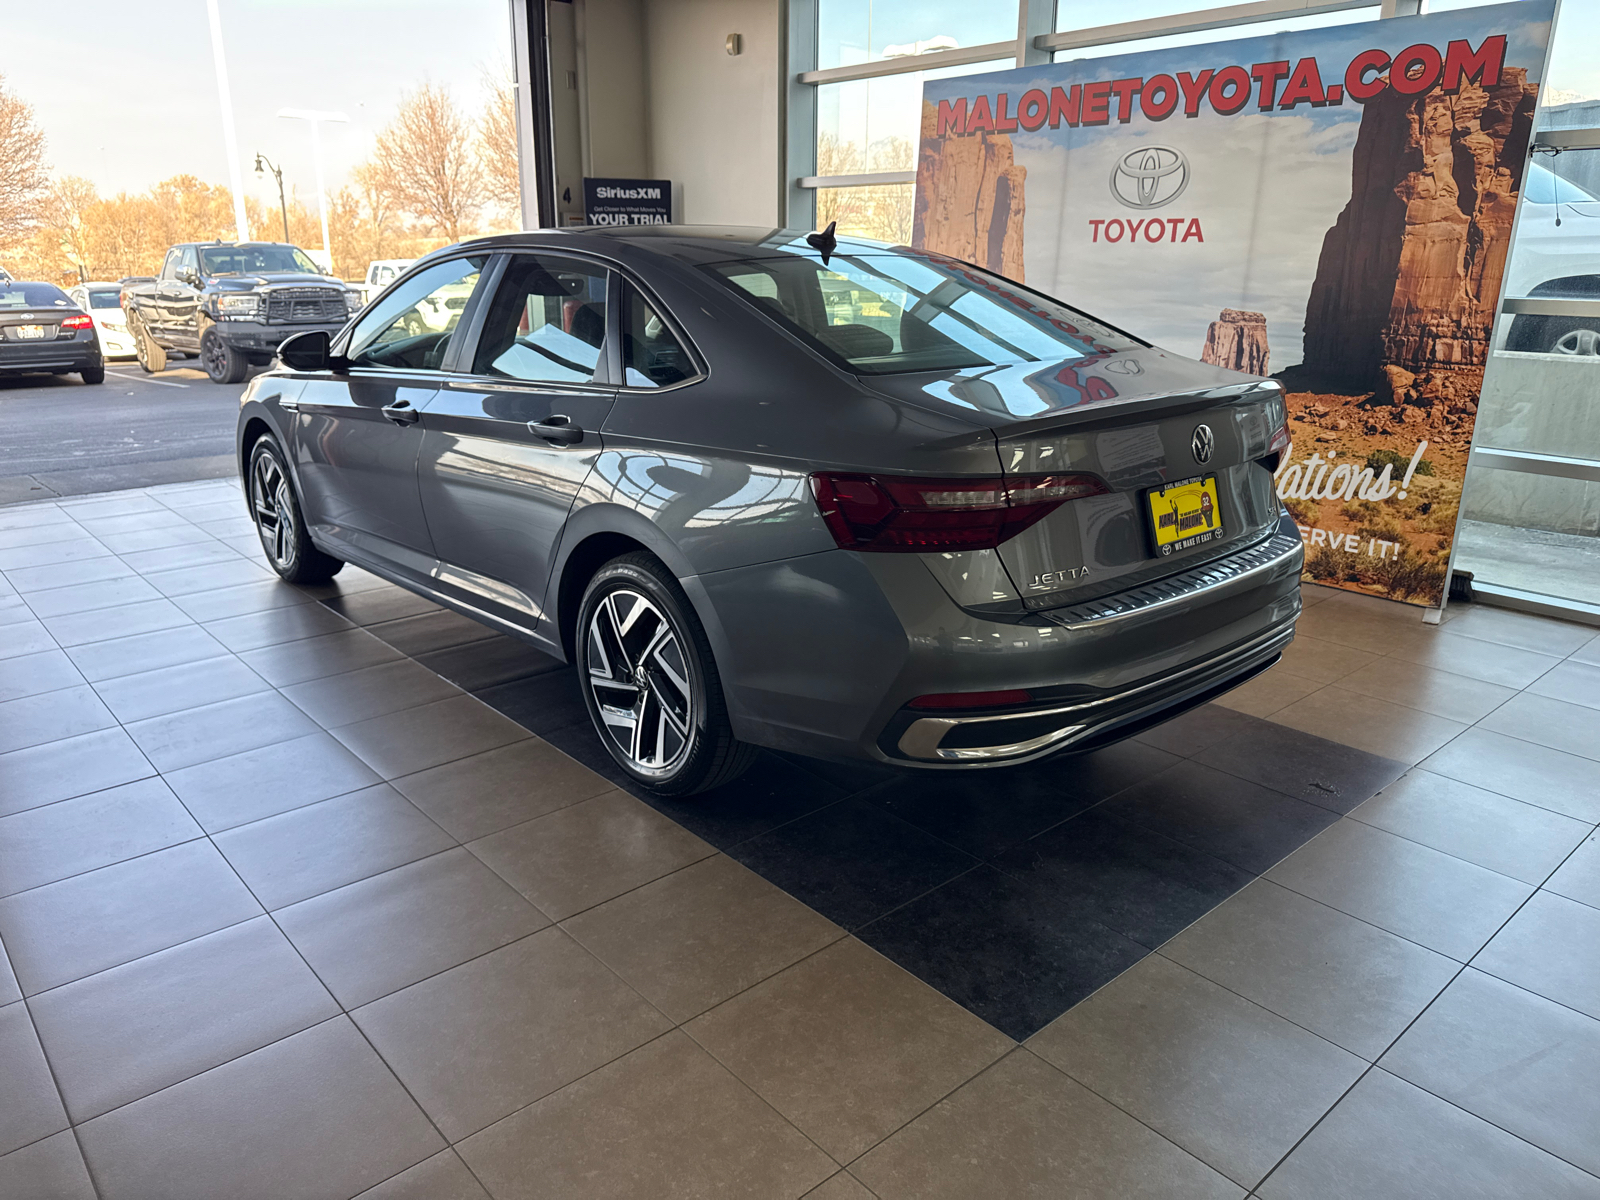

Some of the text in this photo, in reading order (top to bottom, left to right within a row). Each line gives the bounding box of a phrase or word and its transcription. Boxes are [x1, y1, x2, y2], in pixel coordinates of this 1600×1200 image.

[937, 34, 1508, 138] MALONETOYOTA.COM
[596, 187, 661, 199] SiriusXM
[589, 214, 629, 226] YOUR
[630, 214, 671, 226] TRIAL
[1089, 217, 1204, 244] TOYOTA
[1183, 538, 1195, 549] MAKE
[1201, 533, 1212, 543] EASY
[1297, 525, 1400, 561] ERVE IT!
[1028, 565, 1091, 586] JETTA
